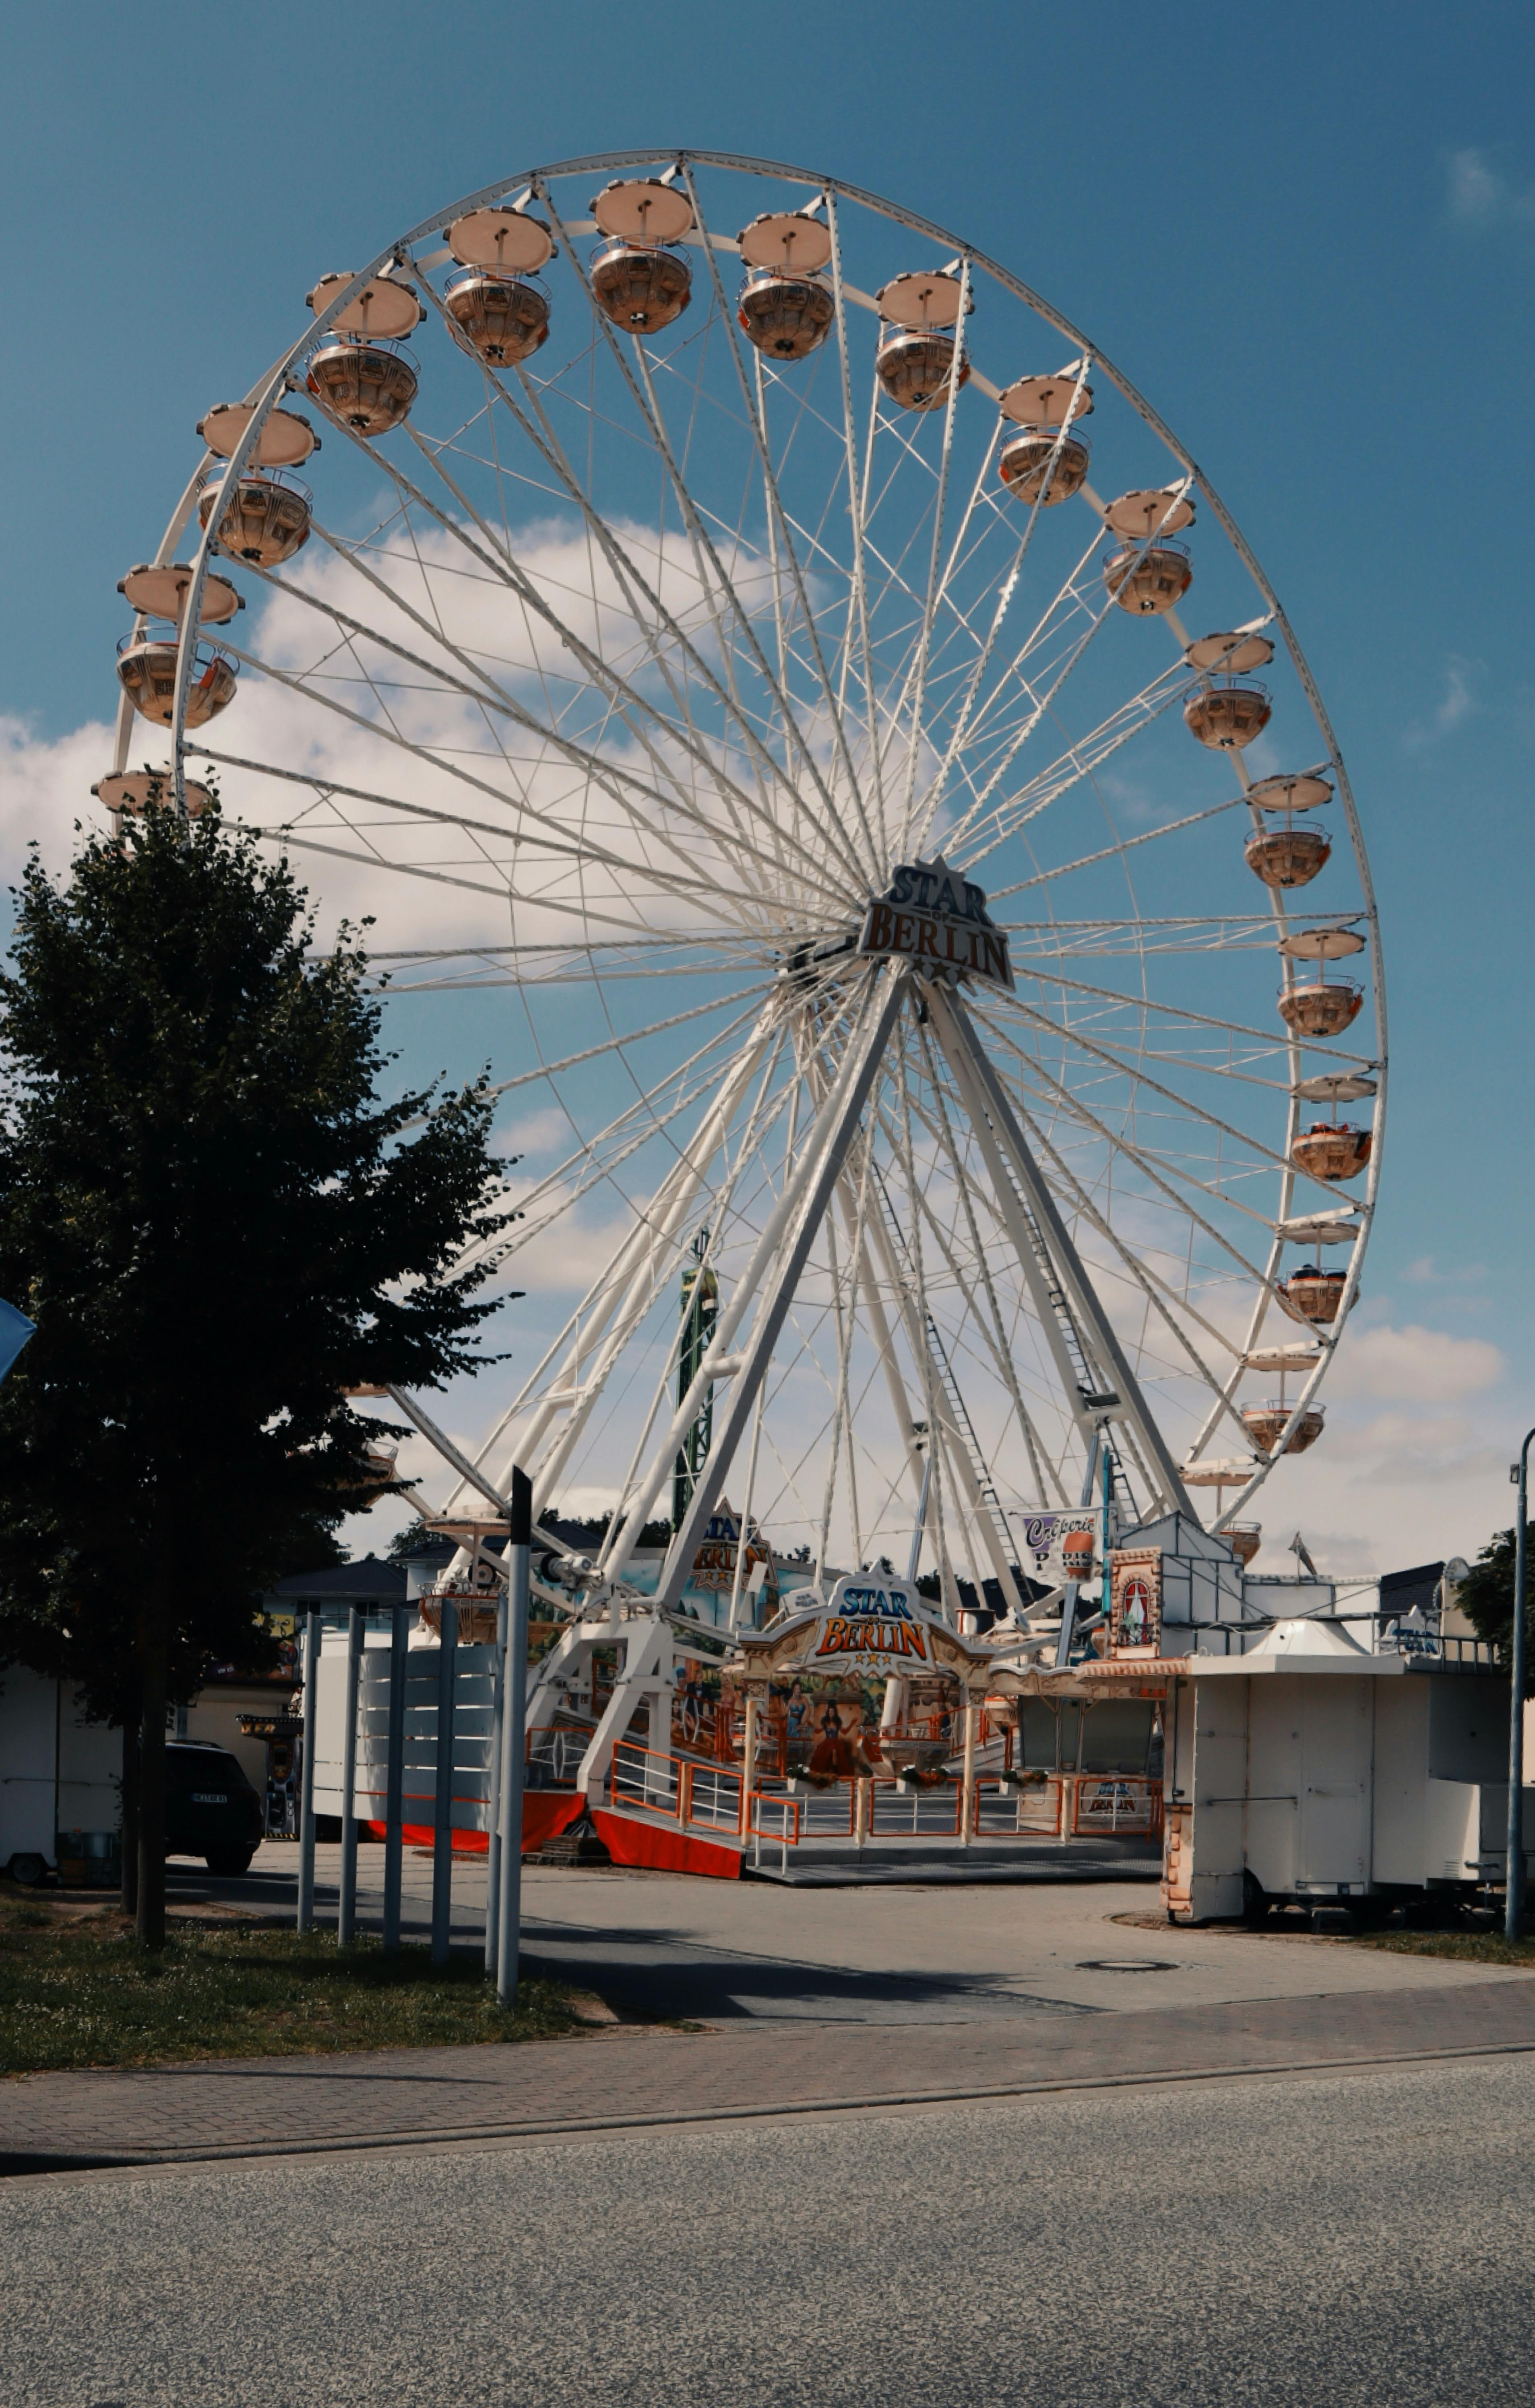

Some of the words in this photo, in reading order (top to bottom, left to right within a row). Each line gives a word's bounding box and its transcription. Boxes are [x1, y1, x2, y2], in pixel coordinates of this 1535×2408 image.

[889, 867, 995, 927] STAR
[932, 911, 950, 922] OF
[864, 902, 1008, 985] BERLIN
[839, 1588, 913, 1620] STAR
[815, 1617, 927, 1661] BERLIN
